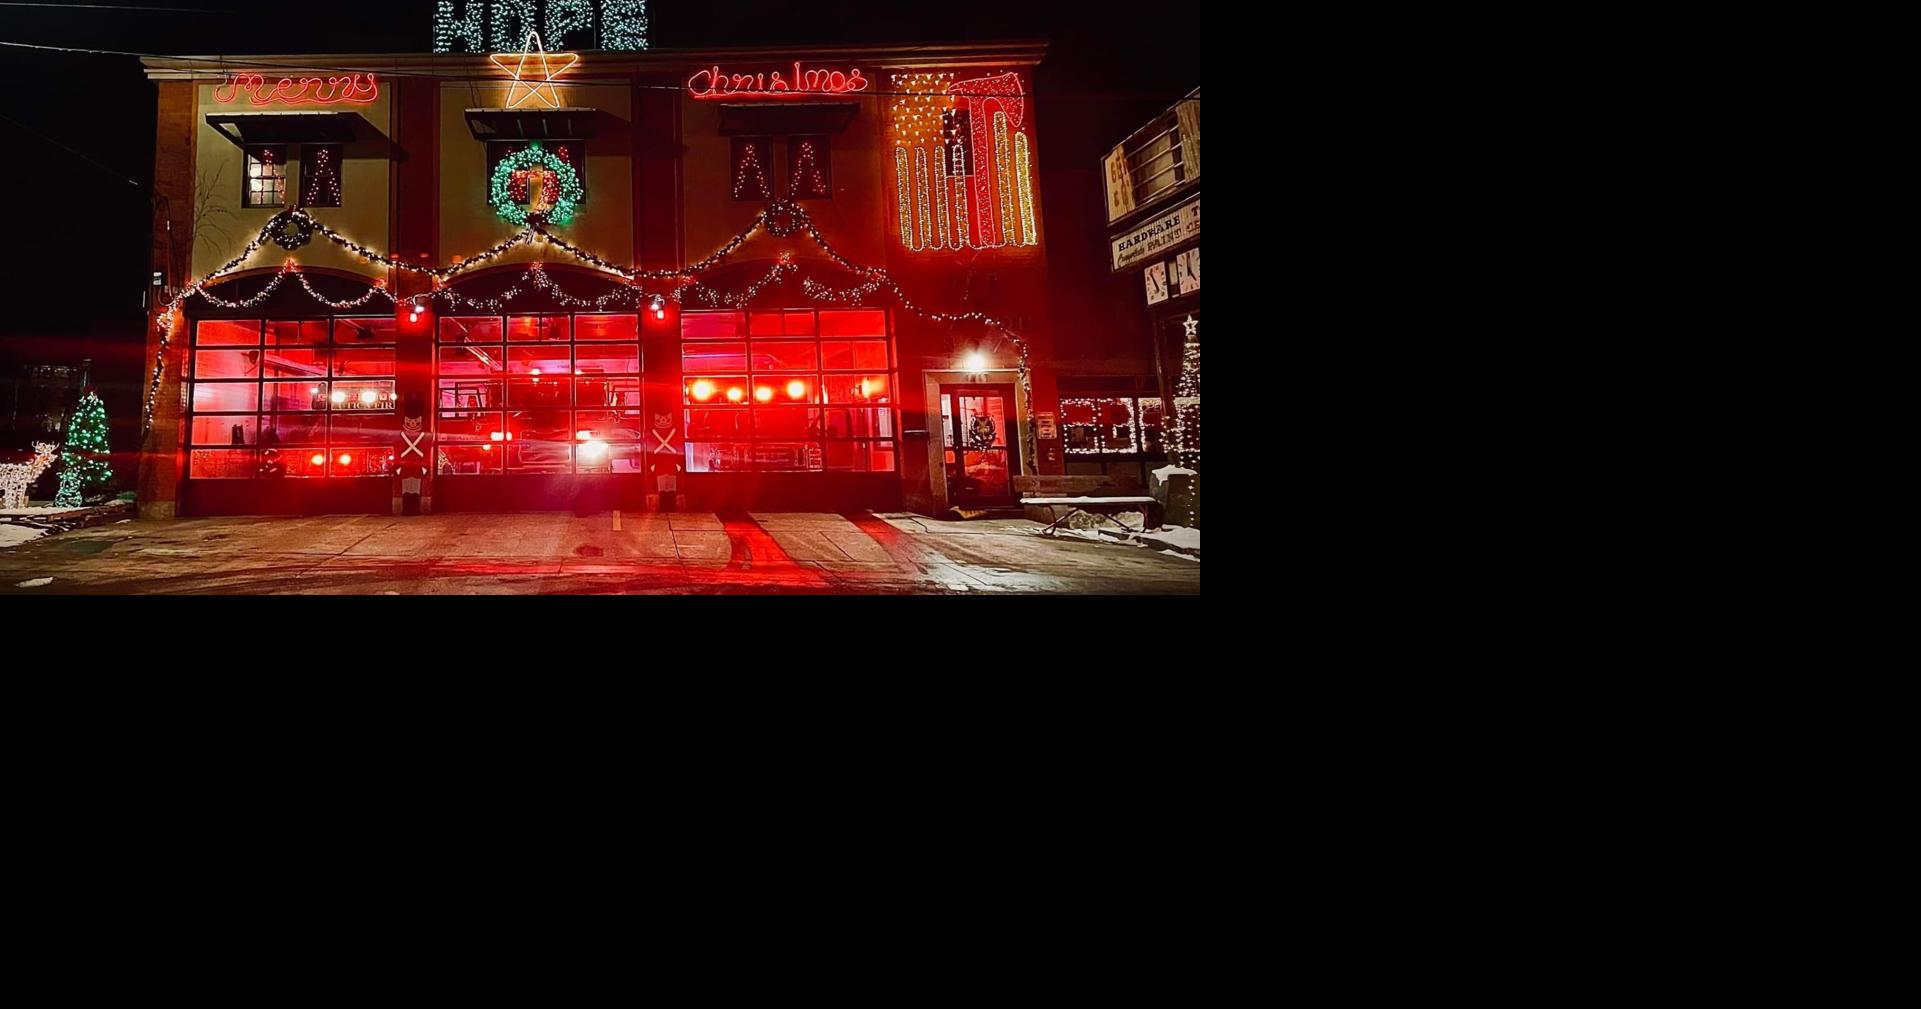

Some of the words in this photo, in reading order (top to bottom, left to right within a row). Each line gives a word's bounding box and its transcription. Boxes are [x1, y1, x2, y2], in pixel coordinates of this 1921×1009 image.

[435, 0, 648, 53] HOPE
[214, 73, 378, 105] Merry
[688, 61, 868, 98] Christmas
[1118, 215, 1181, 252] HARDWARE
